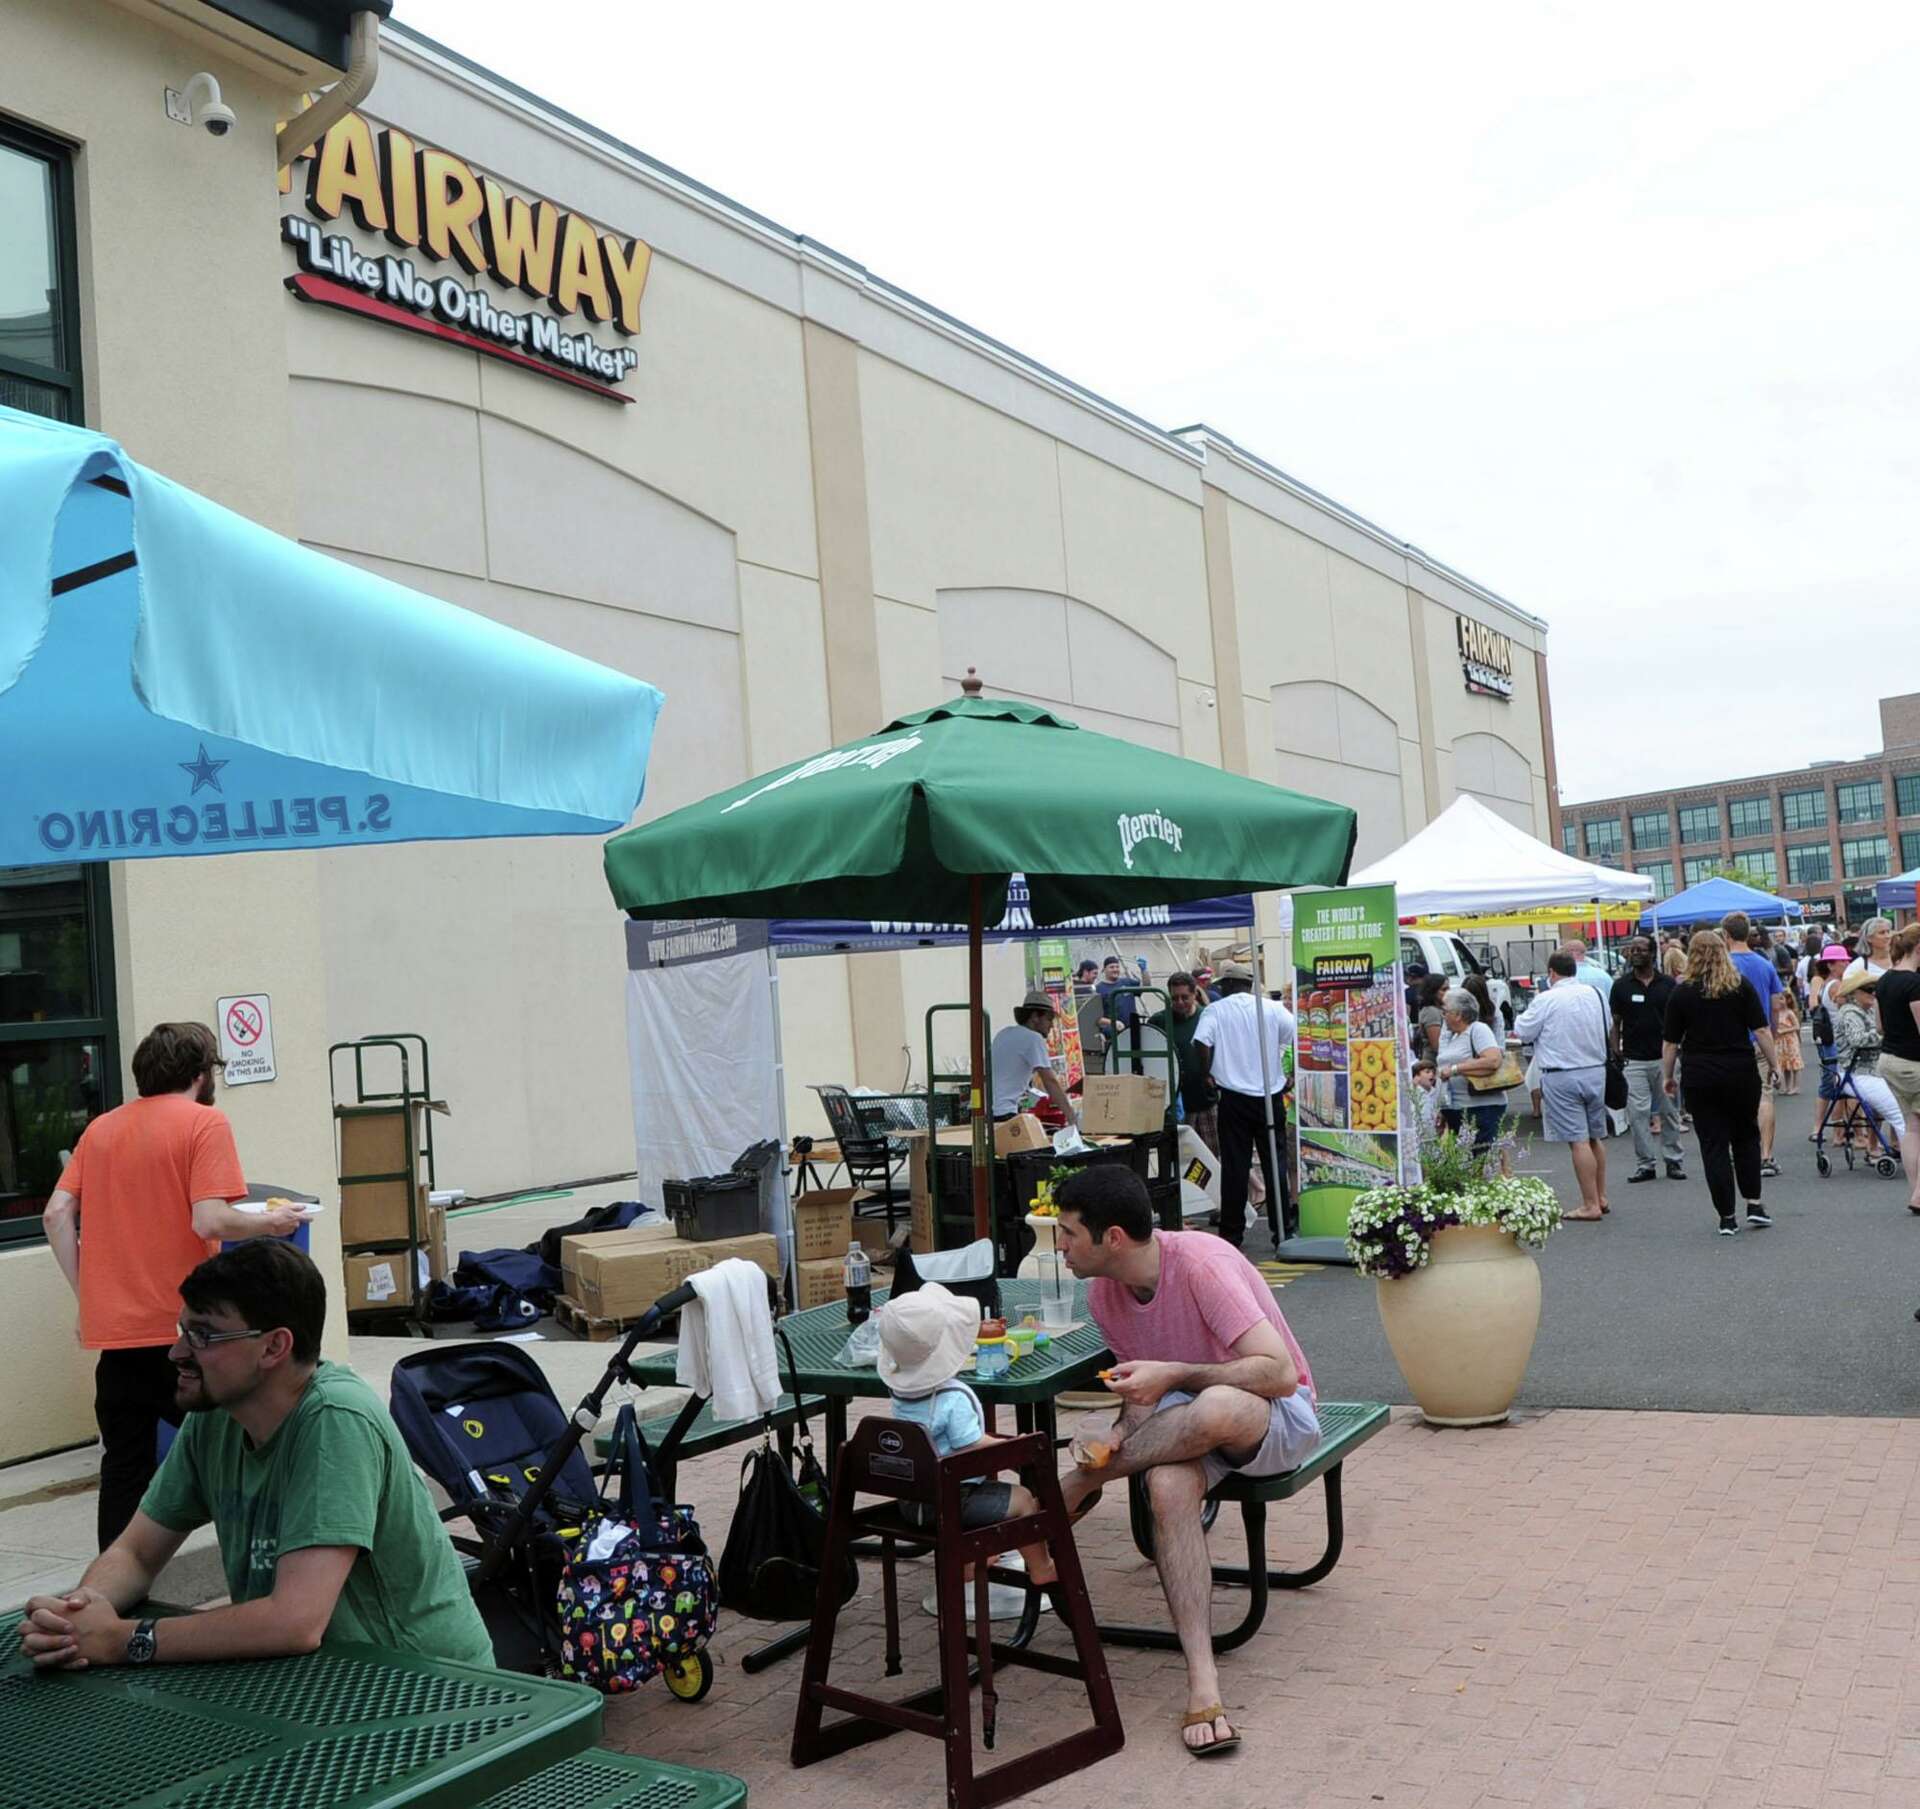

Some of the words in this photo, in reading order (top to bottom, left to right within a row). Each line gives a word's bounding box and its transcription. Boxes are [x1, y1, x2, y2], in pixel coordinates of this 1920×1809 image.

[385, 258, 434, 309] No
[439, 277, 528, 342] Other
[1459, 615, 1513, 676] FAIRWAY
[1316, 909, 1330, 924] THE
[1301, 926, 1335, 943] GREATEST
[1337, 924, 1357, 941] FOOD
[1358, 922, 1383, 940] STORE
[1316, 957, 1370, 976] FAIRWAY
[241, 1049, 253, 1057] NO
[227, 1069, 235, 1077] IN
[236, 1068, 252, 1076] THIS
[253, 1065, 272, 1074] AREA
[231, 1057, 265, 1068] SMOKING
